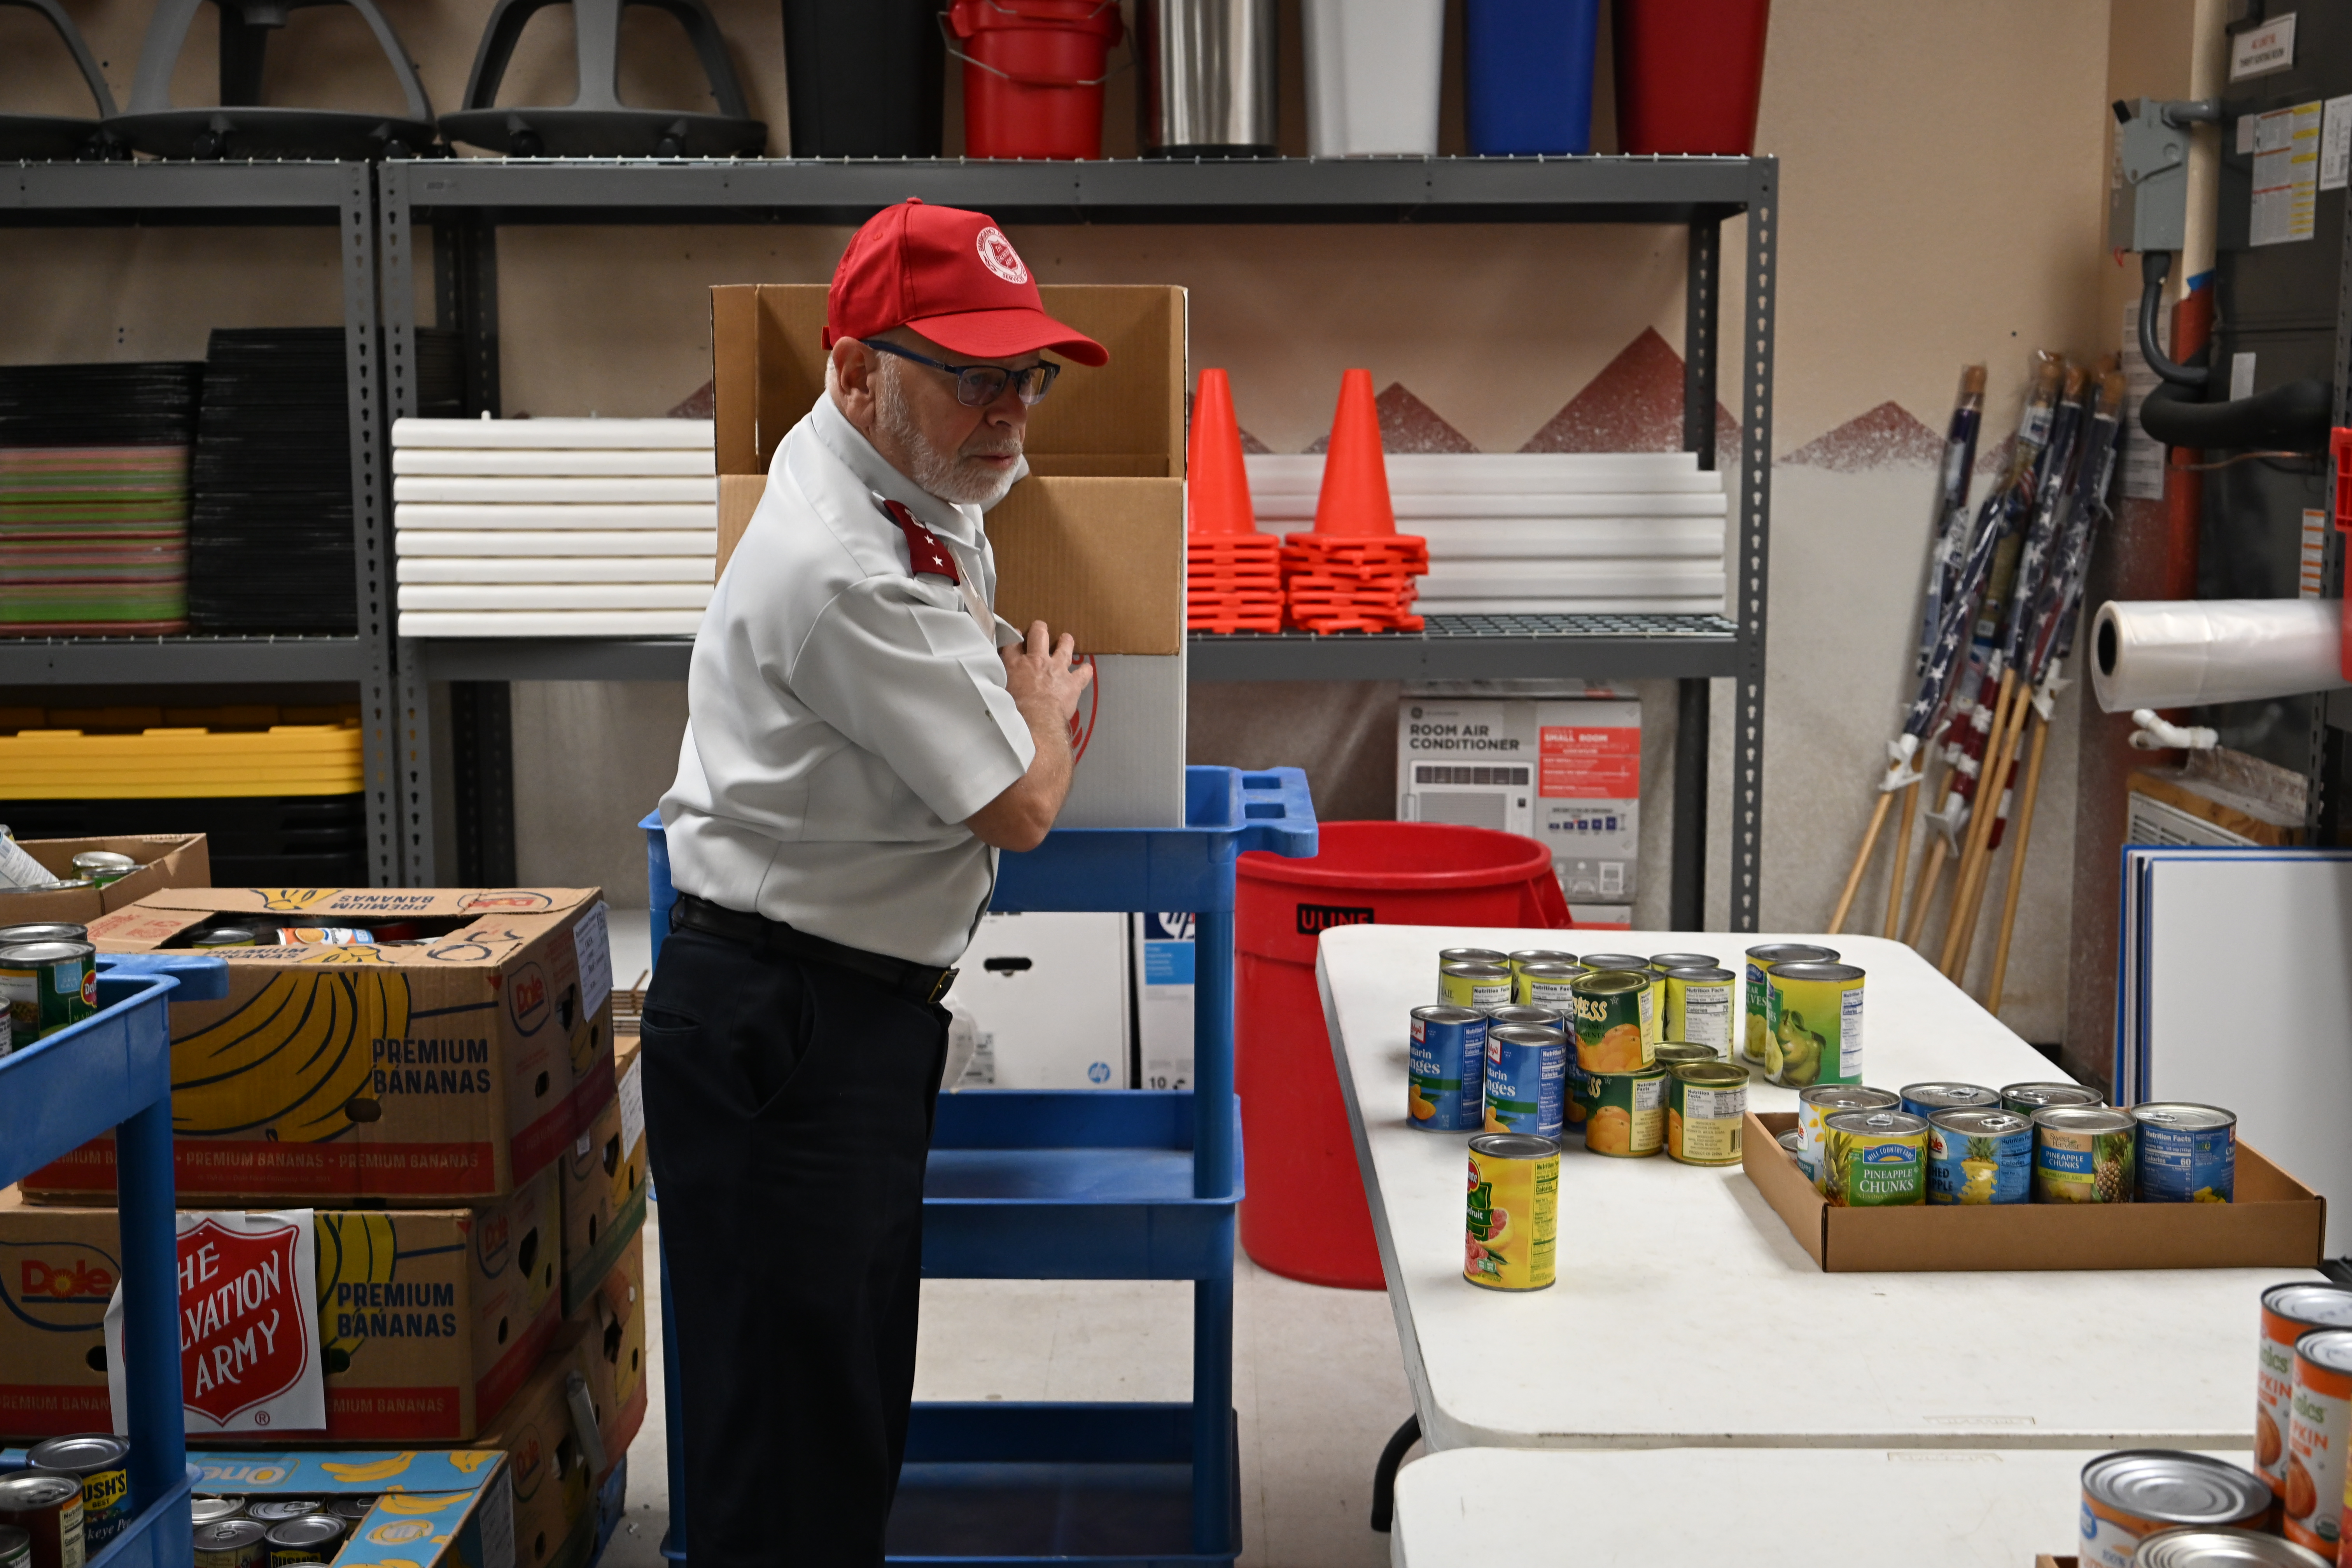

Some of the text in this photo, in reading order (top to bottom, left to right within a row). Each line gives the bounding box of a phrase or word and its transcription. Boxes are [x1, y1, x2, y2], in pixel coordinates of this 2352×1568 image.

[1410, 724, 1489, 737] ROOM AIR
[1410, 738, 1520, 751] CONDITIONER
[516, 974, 543, 1013] Dole
[372, 1039, 488, 1064] PREMIUM
[1543, 1049, 1561, 1057] Nutrition
[1409, 1058, 1440, 1074] nges
[373, 1069, 491, 1094] BANANAS
[1486, 1079, 1516, 1097] nges
[2001, 1136, 2024, 1144] Nutrition
[2146, 1130, 2192, 1143] Nutrition Facts
[187, 1152, 324, 1167] PREMIUM BANANAS
[339, 1153, 479, 1167] PREMIUM BANANAS
[1867, 1146, 1914, 1162] HILL COUNTRY FARE
[2046, 1150, 2084, 1162] PINEAPPLE
[2145, 1155, 2191, 1166] Calories 60
[2049, 1158, 2080, 1169] CHUNKS
[1864, 1168, 1913, 1180] PINEAPPLE
[1536, 1185, 1553, 1193] Calories
[1859, 1179, 1914, 1193] CHUNKS
[485, 1214, 509, 1253] Dole
[178, 1241, 220, 1296] HE
[21, 1259, 112, 1298] Dole
[180, 1249, 281, 1352] LVATION
[337, 1283, 454, 1307] PREMIUM
[337, 1313, 457, 1337] BANANAS
[195, 1309, 280, 1399] ARMY
[62, 1396, 111, 1410] BANAN
[377, 1398, 445, 1412] BANANAS
[82, 1473, 125, 1502] USH'S
[92, 1498, 110, 1508] BEST
